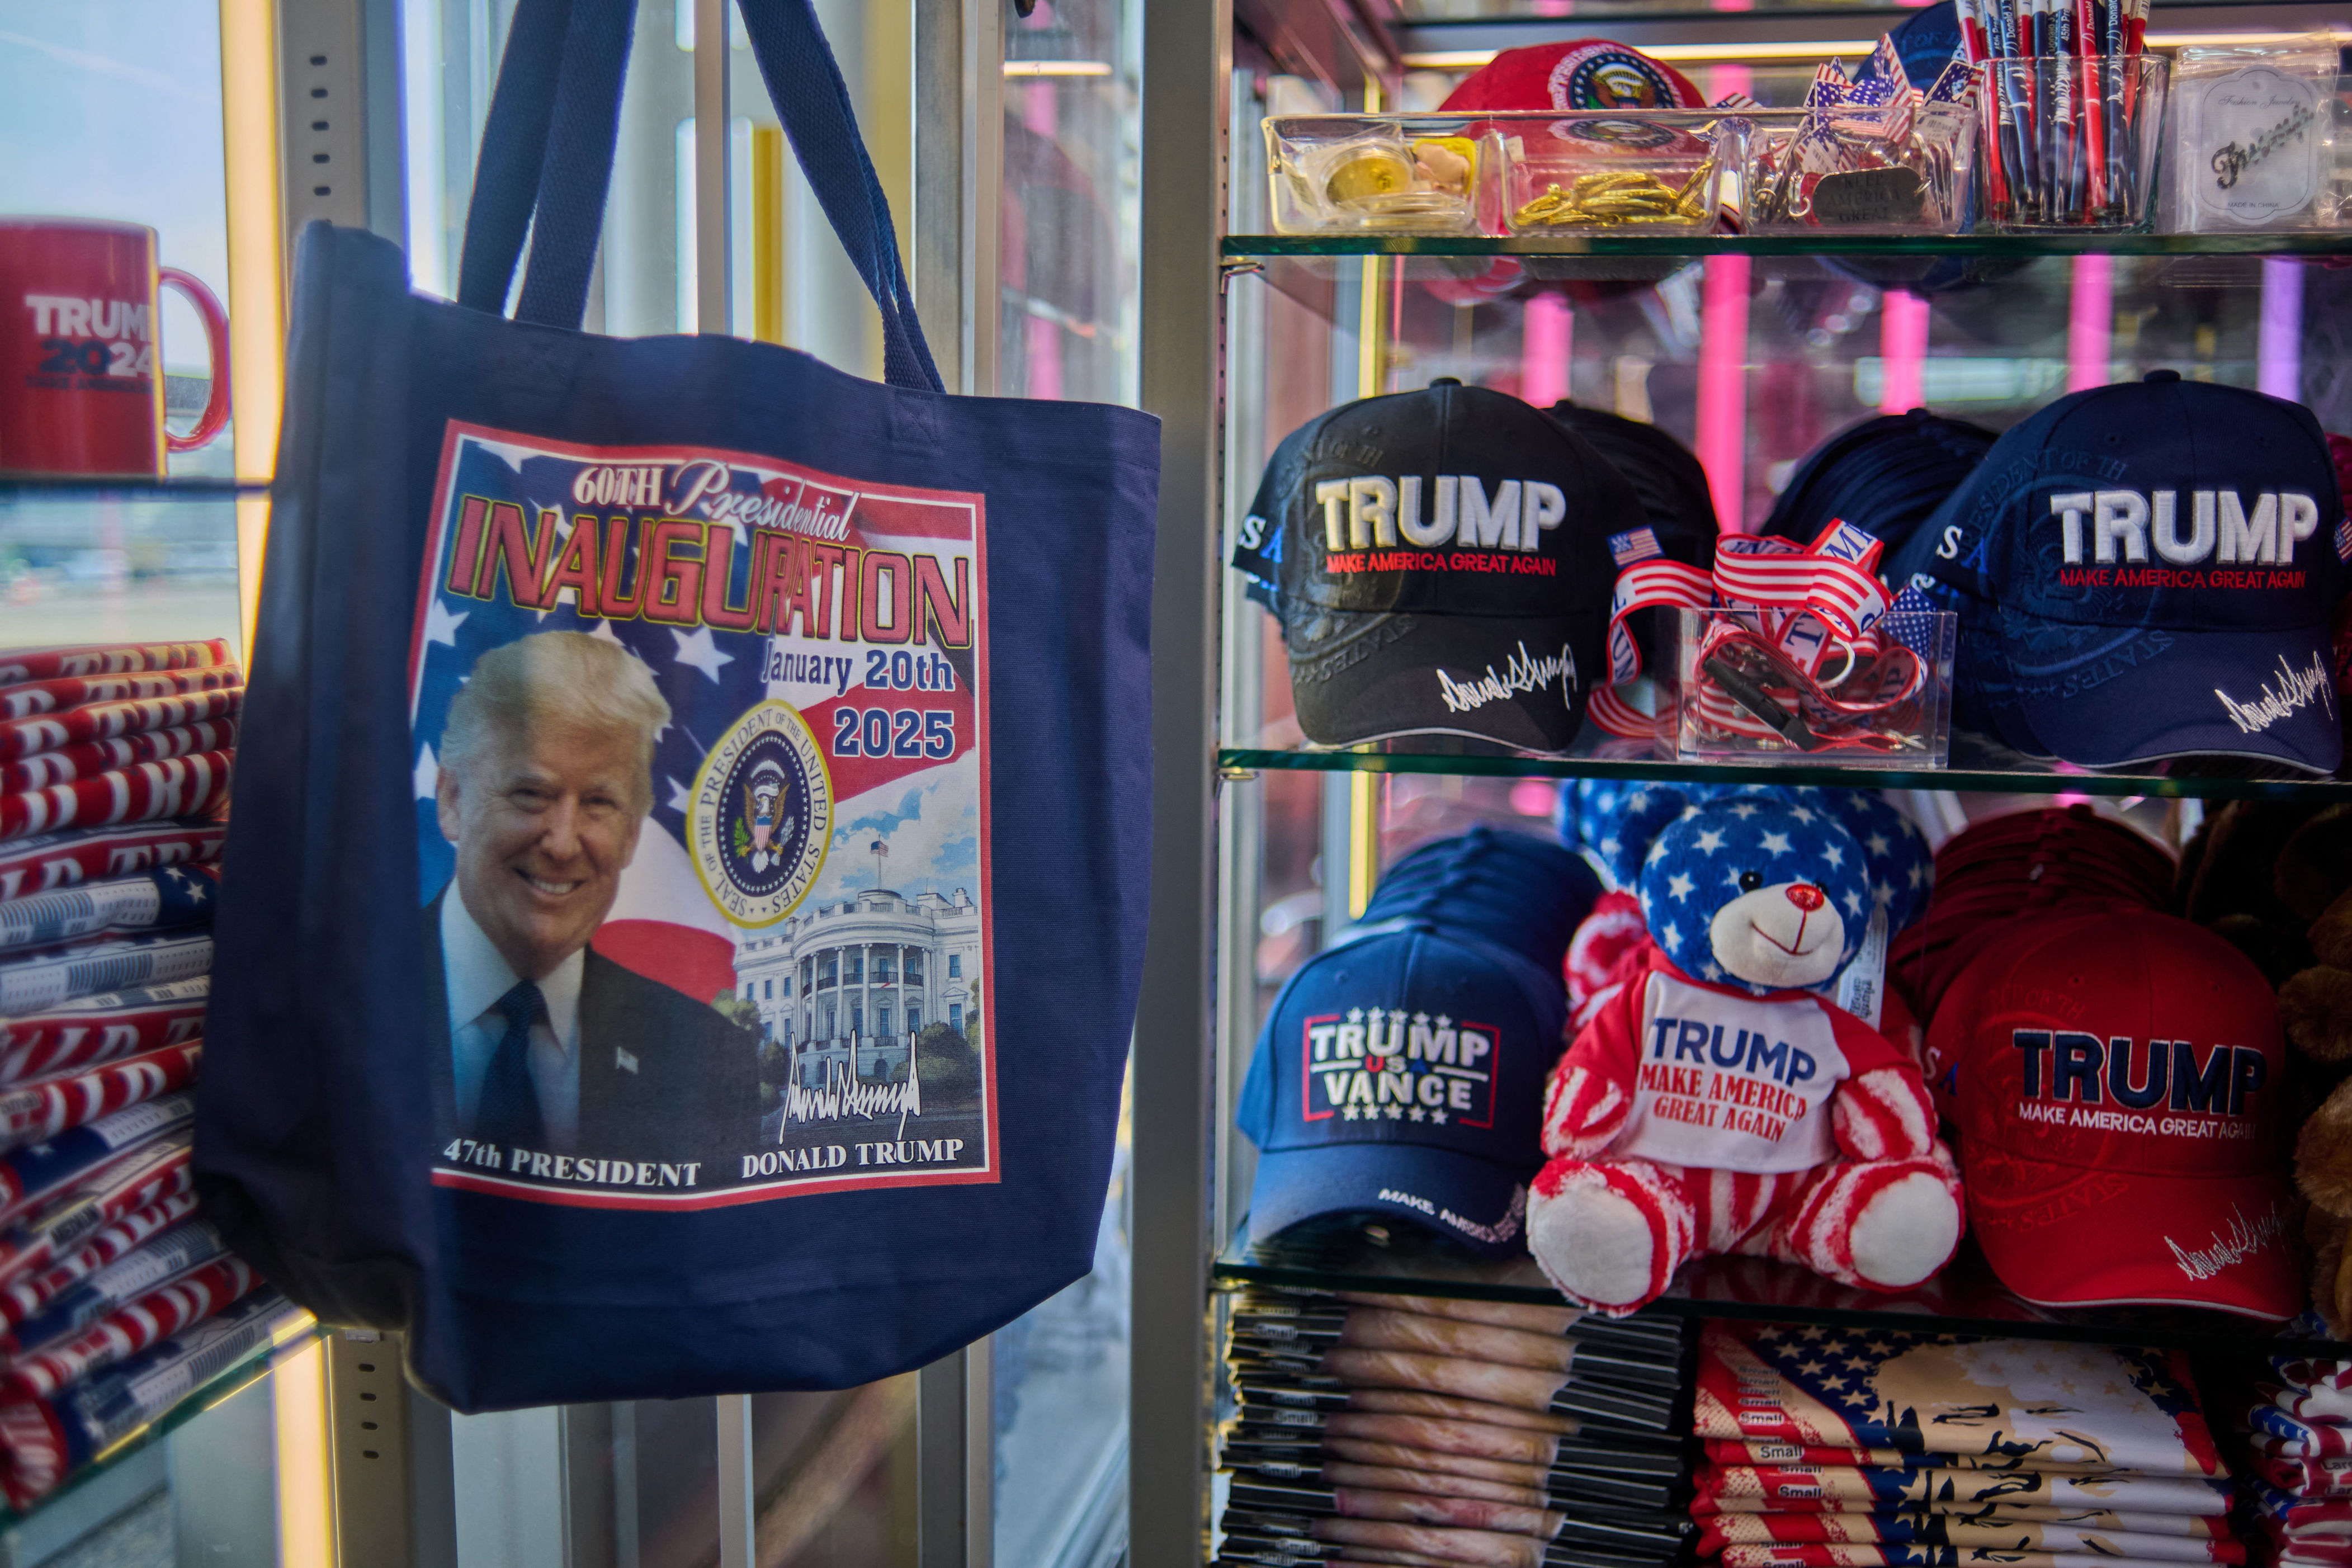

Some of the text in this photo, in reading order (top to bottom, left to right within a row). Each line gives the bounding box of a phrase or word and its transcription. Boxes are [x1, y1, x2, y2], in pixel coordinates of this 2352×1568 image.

[2003, 12, 2016, 39] Donald
[2061, 26, 2070, 41] 45th
[2085, 2, 2095, 30] Donald
[2218, 94, 2301, 110] Fashion Jewelry
[1826, 187, 1901, 206] AMERICA
[1844, 173, 1884, 189] KEEP
[1839, 207, 1888, 223] GREAT
[25, 294, 153, 342] TRUM
[2061, 450, 2093, 471] OF
[572, 457, 861, 542] 60TH Presidential
[1315, 475, 1566, 552] TRUMP
[2050, 490, 2319, 566] TRUMP
[445, 493, 972, 649] INAUGURATION
[1326, 552, 1557, 577] MAKE AMERICA GREAT AGAIN
[2060, 569, 2306, 589] MAKE AMERICA GREAT AGAIN
[761, 639, 956, 697] January 20th
[2062, 629, 2176, 699] STATES
[832, 706, 955, 759] 2025
[700, 708, 828, 917] SEAL OF THE PRESIDENT OF THE UNITED STATES
[1310, 1021, 1490, 1067] TRUMP
[1652, 1017, 1817, 1087] TRUMP
[1365, 1055, 1429, 1074] USA
[2013, 1028, 2269, 1118] TRUMP
[1324, 1071, 1472, 1111] VANCE
[1639, 1062, 1807, 1123] MAKE AMERICA
[1653, 1095, 1787, 1144] GREAT AGAIN
[2018, 1101, 2257, 1140] MAKE AMERICA GREAT AGAIN
[443, 1137, 965, 1188] 47th PRESIDENT DONALD TRUMP
[1378, 1188, 1435, 1216] MAKE
[1760, 1445, 1802, 1458] Small
[1779, 1465, 1822, 1473] Small
[1779, 1485, 1822, 1498] Small
